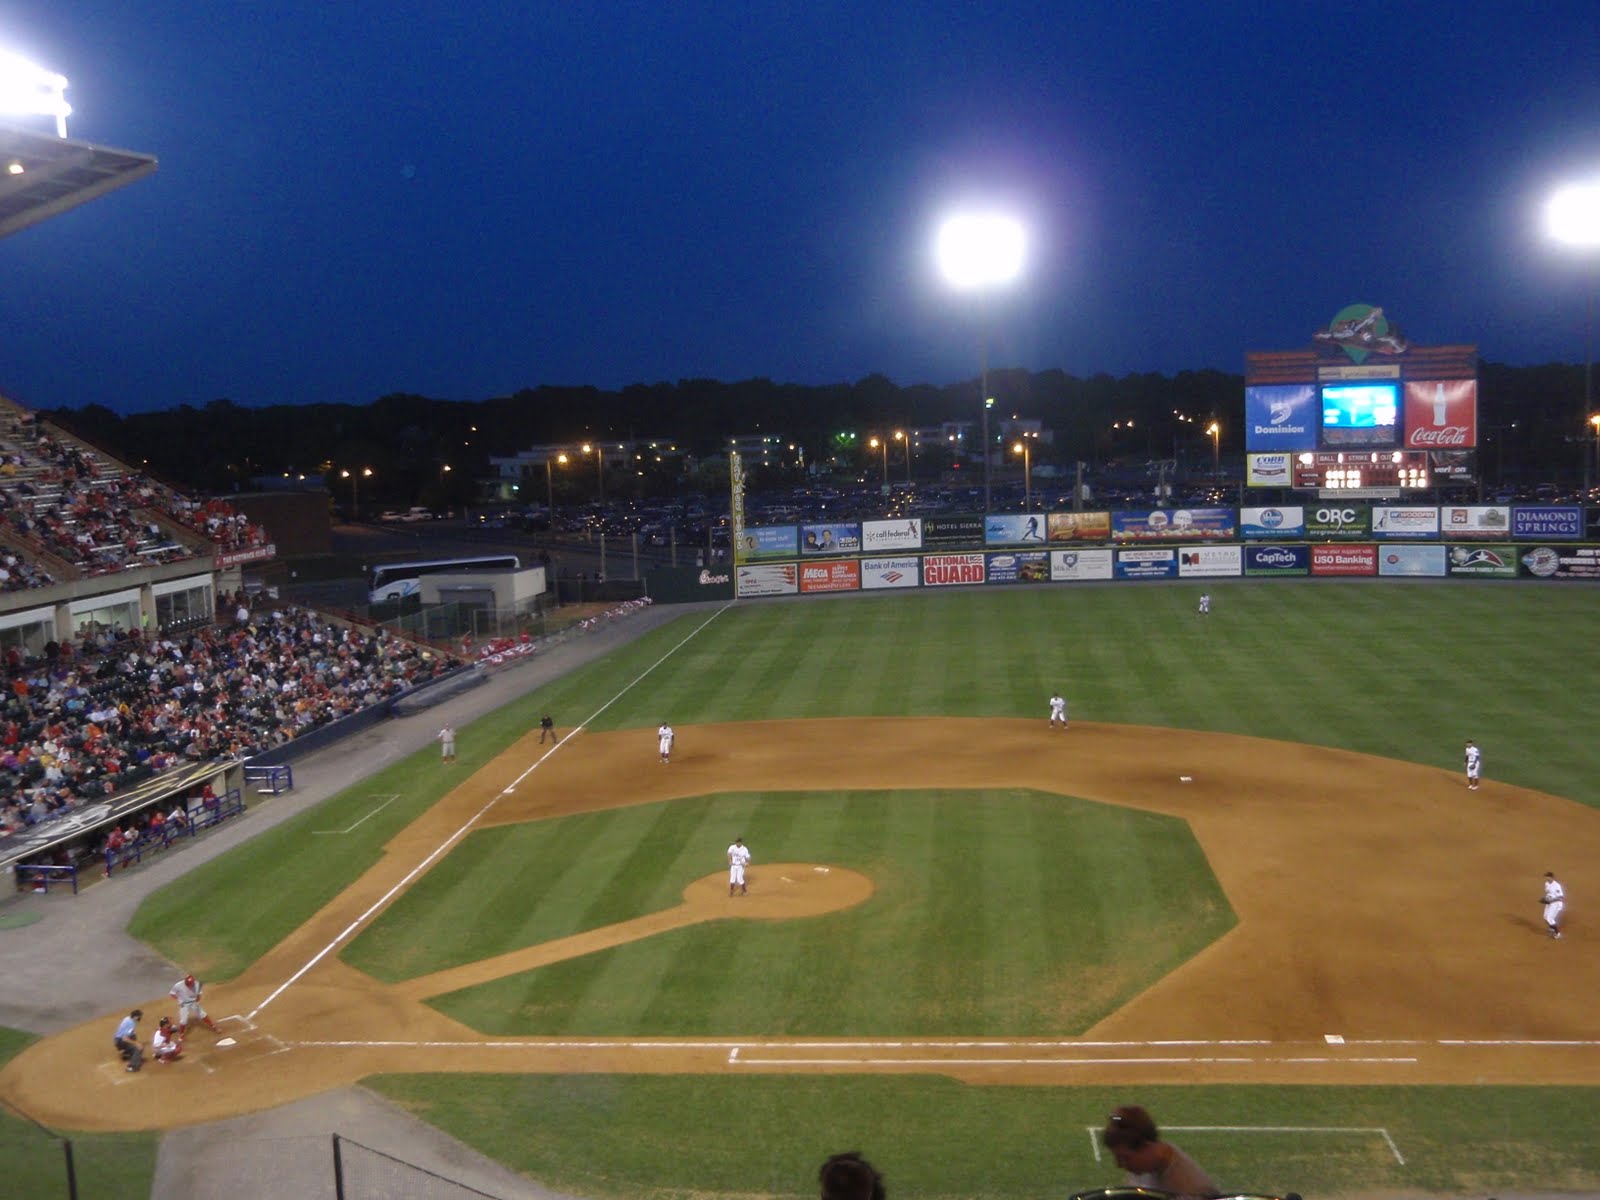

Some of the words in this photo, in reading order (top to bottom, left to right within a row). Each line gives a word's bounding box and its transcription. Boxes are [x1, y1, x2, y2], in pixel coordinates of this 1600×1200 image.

[1254, 425, 1304, 434] Dominion
[1410, 427, 1468, 445] Coca-Cola
[1256, 455, 1285, 465] COBB
[1316, 509, 1356, 525] ORC
[1517, 512, 1577, 521] DIAMOND
[936, 522, 957, 530] HOTEL
[960, 521, 982, 529] SIERRA
[1517, 523, 1576, 532] SPRINGS
[924, 555, 970, 566] NATIONAL
[1256, 552, 1296, 564] CapTech
[1314, 555, 1333, 564] USO
[1335, 555, 1373, 565] Banking
[864, 561, 882, 570] Bank
[883, 561, 890, 569] of
[891, 560, 919, 569] America
[803, 568, 828, 579] MEGA
[925, 565, 984, 584] GUARD
